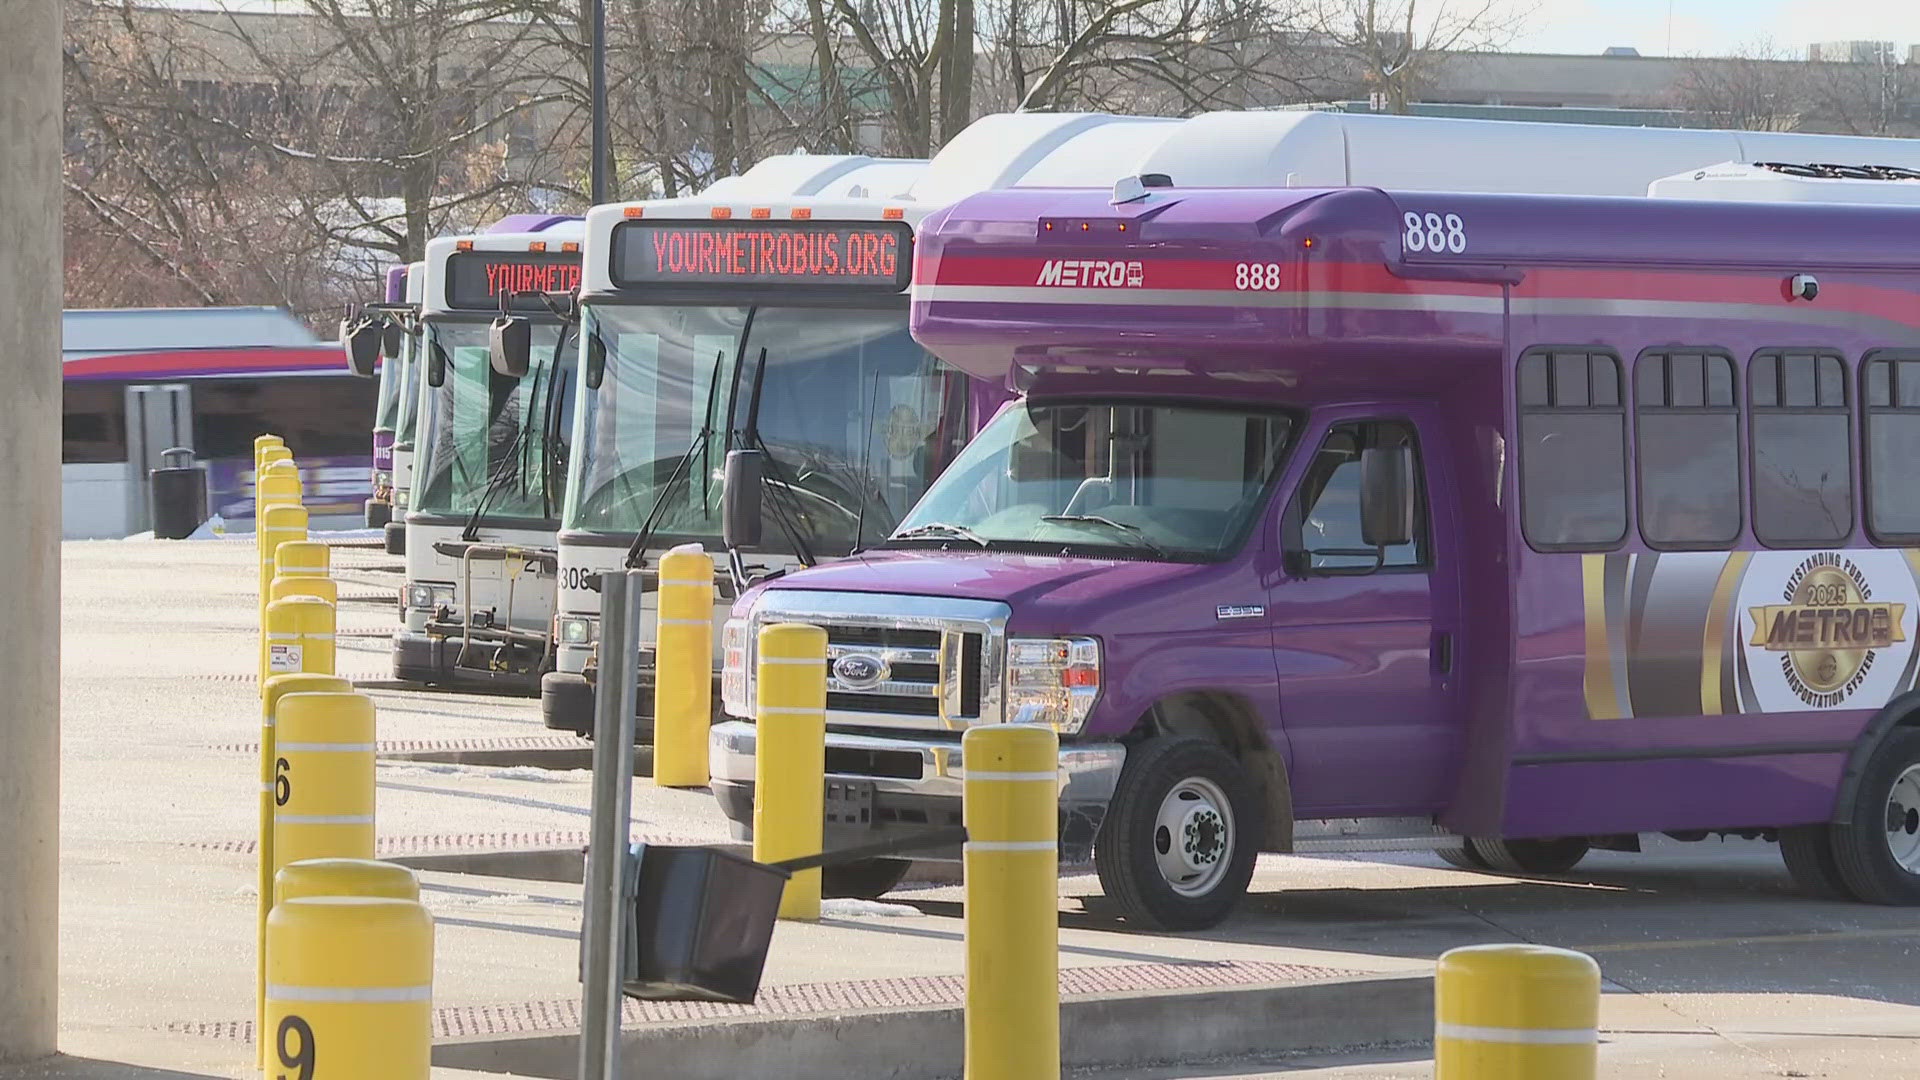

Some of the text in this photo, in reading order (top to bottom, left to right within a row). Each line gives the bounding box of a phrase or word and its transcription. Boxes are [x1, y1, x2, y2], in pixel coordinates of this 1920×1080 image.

[1404, 211, 1467, 254] 888
[652, 230, 897, 276] YOURMETROBUS.ORG
[1036, 260, 1126, 287] METRO
[1235, 263, 1281, 290] 888
[558, 567, 590, 590] 308
[1783, 551, 1873, 602] OUTSTANDING PUBLIC
[1807, 584, 1847, 607] 2025
[1766, 607, 1871, 644] METRO
[843, 661, 869, 677] Ford
[1780, 650, 1876, 709] TRANSPORTATION SYSTEM
[275, 757, 291, 807] 6
[276, 1015, 316, 1080] 9
